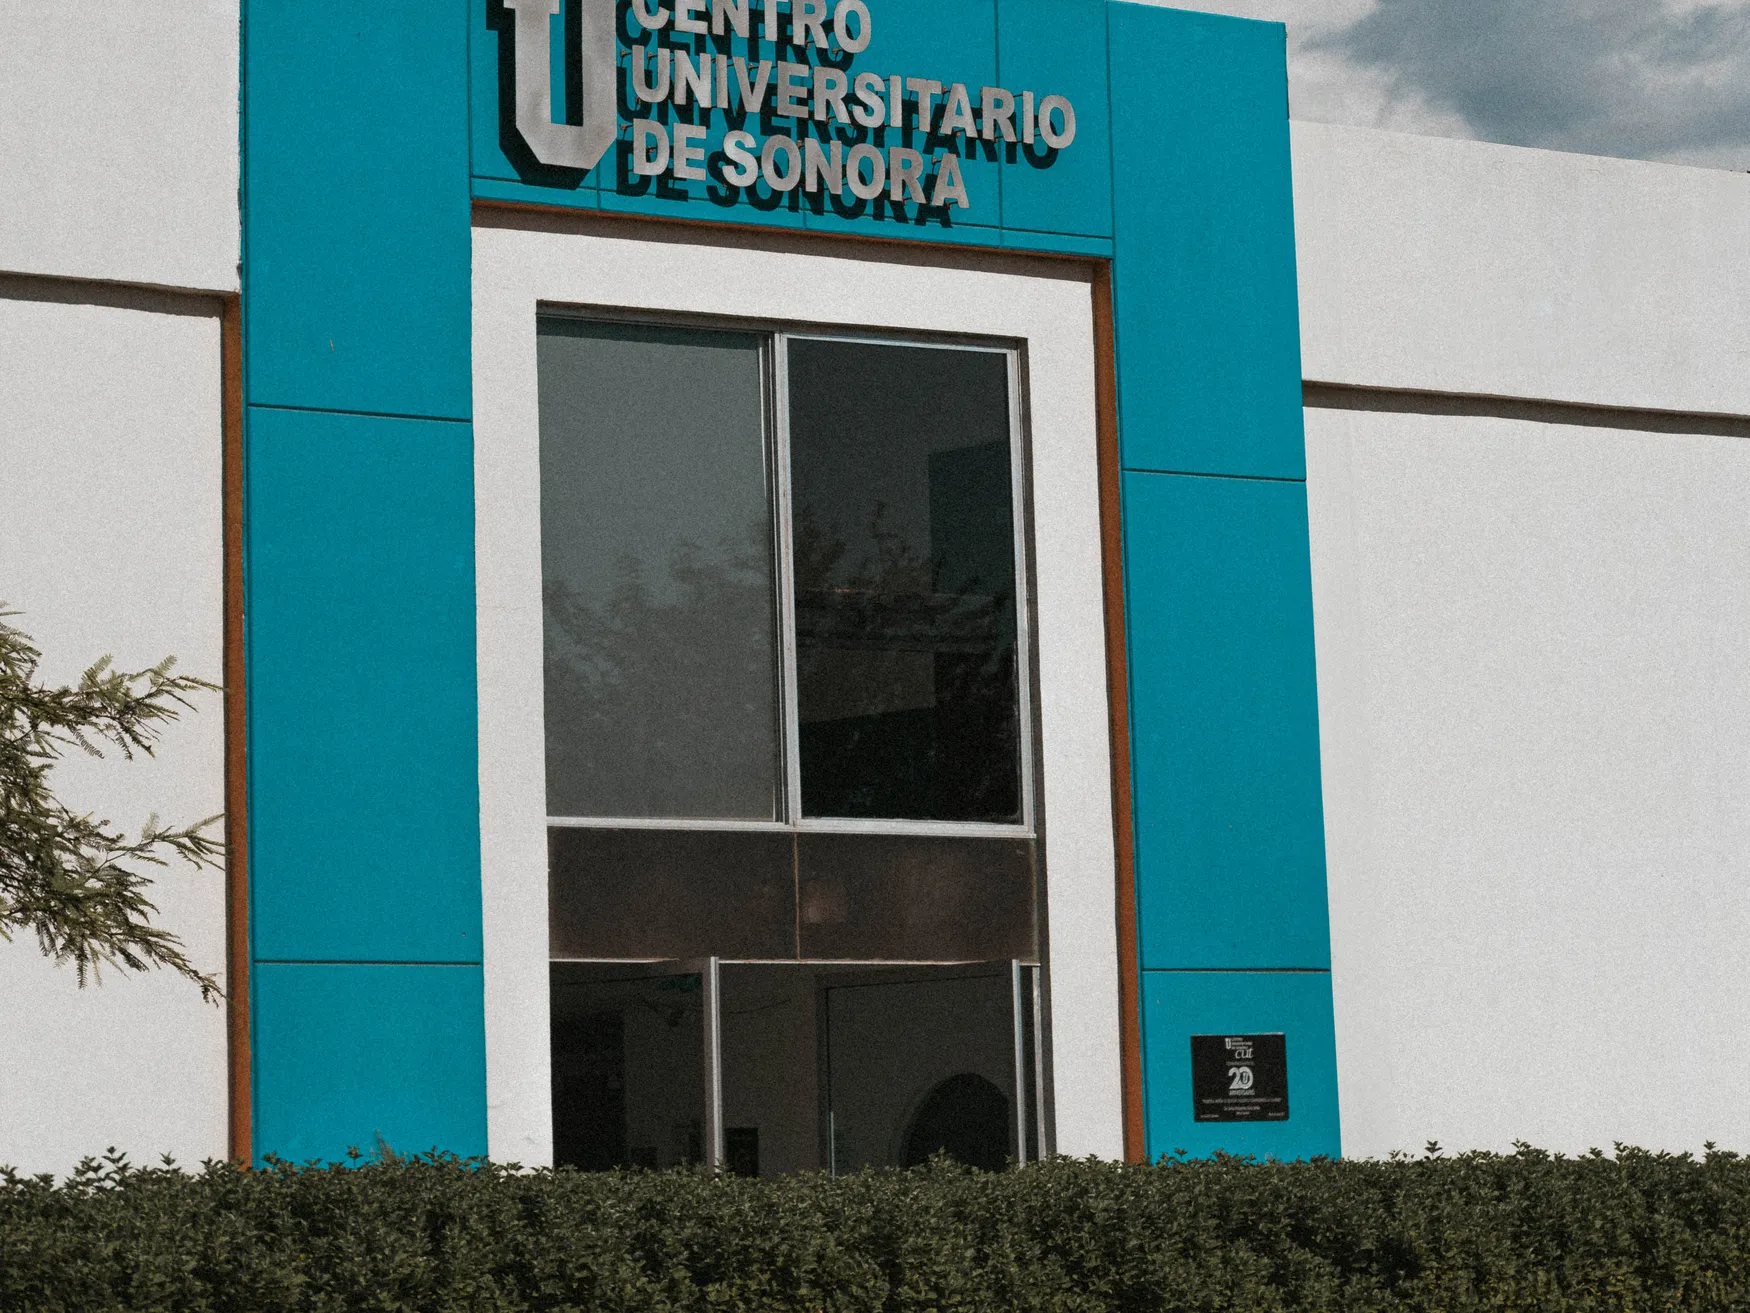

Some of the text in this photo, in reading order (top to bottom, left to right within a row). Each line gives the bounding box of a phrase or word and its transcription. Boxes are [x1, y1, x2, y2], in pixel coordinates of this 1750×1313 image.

[632, 44, 1077, 149] UNIVERSITARIO
[632, 117, 971, 209] DE SONORA
[1228, 1066, 1253, 1089] 20
